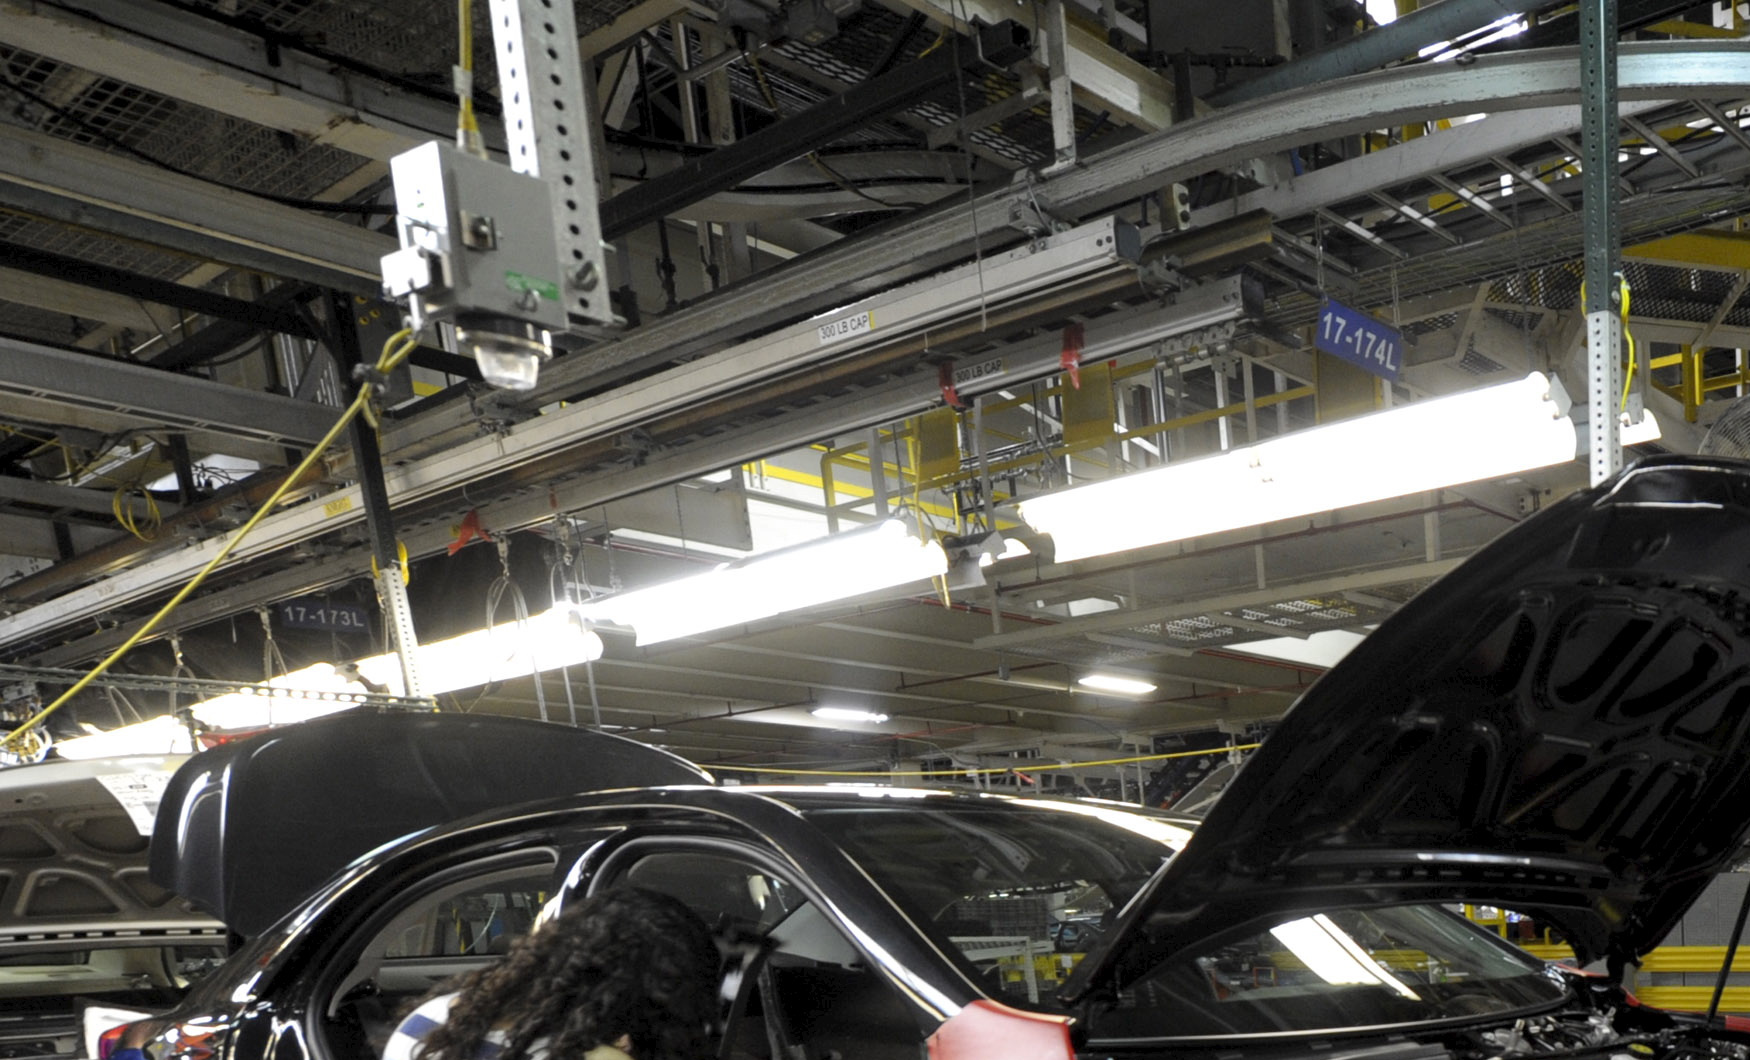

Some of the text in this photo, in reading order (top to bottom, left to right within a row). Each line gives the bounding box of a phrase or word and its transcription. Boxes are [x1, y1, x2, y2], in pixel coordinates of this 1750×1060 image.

[820, 315, 868, 339] 300 LB CAP
[1323, 312, 1396, 371] 17-174L
[956, 360, 1002, 383] 300 LB CAP
[284, 606, 364, 627] 17-173L
